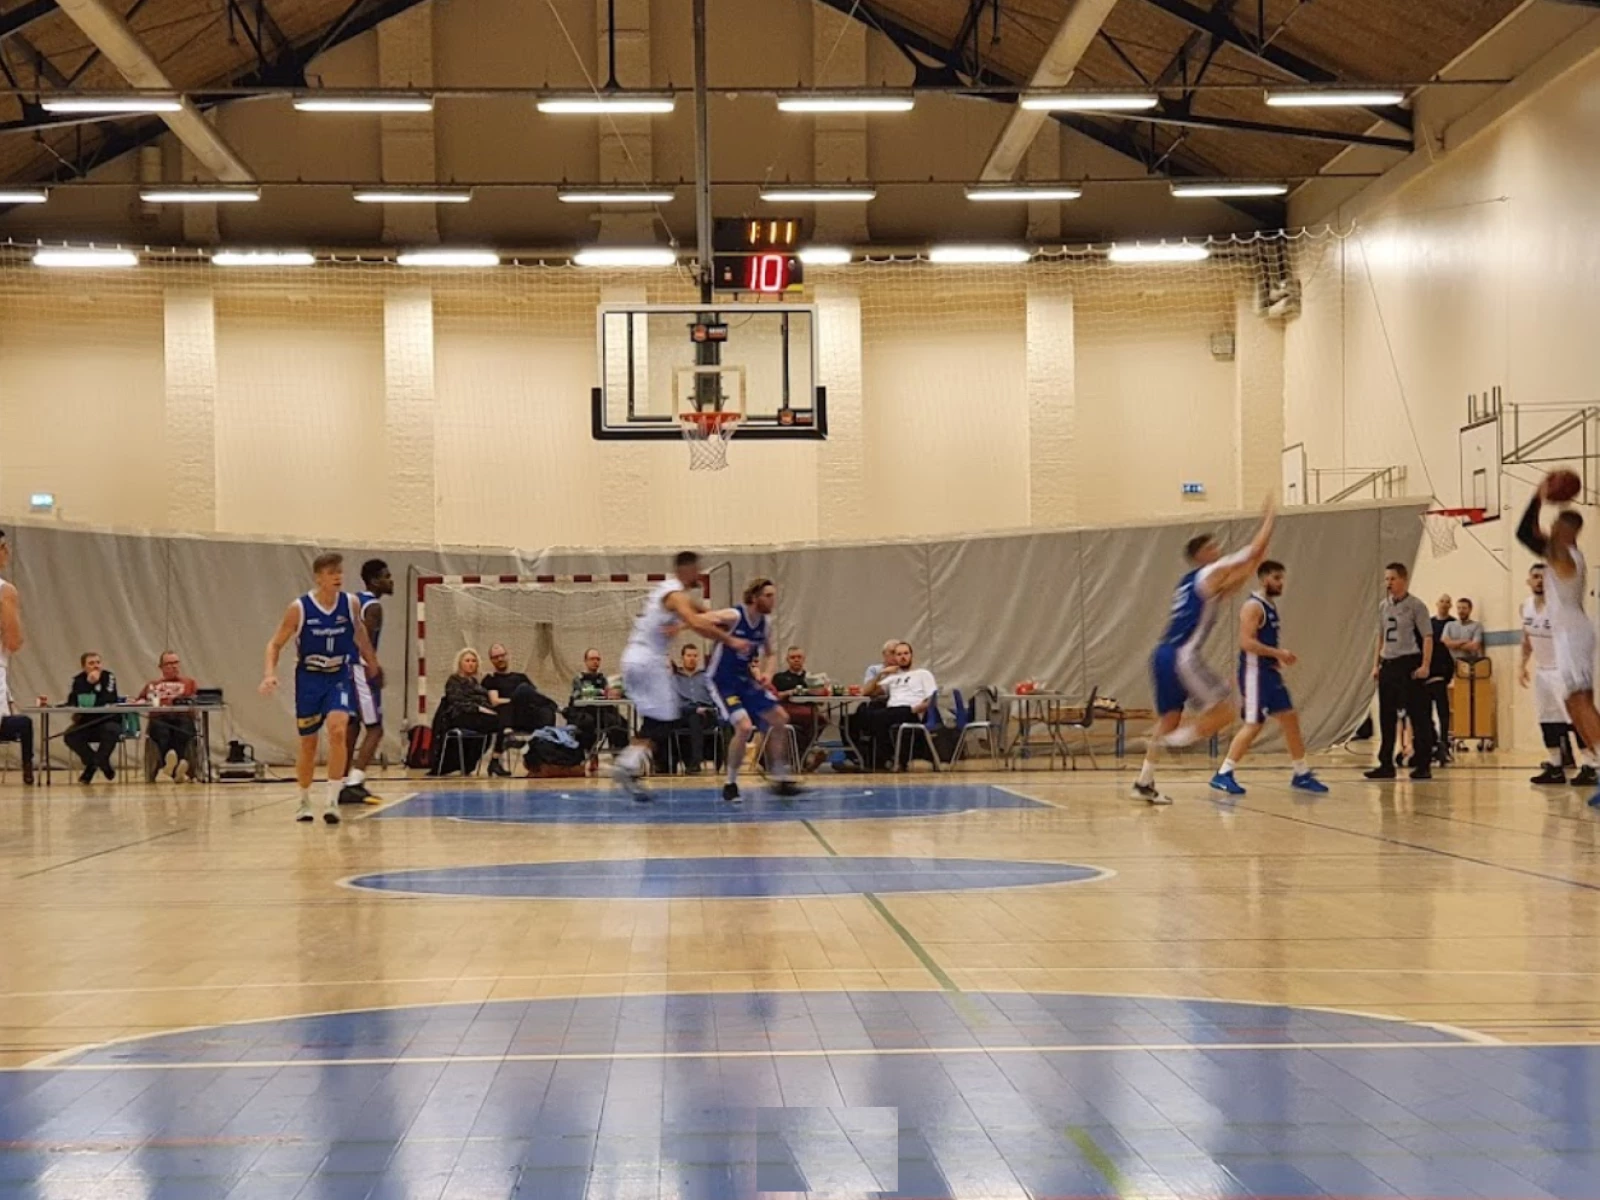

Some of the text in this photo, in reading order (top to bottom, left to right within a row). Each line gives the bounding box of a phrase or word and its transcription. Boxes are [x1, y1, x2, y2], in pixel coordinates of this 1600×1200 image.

[749, 221, 793, 245] 1:11
[750, 254, 783, 292] 10
[1386, 617, 1398, 642] 2
